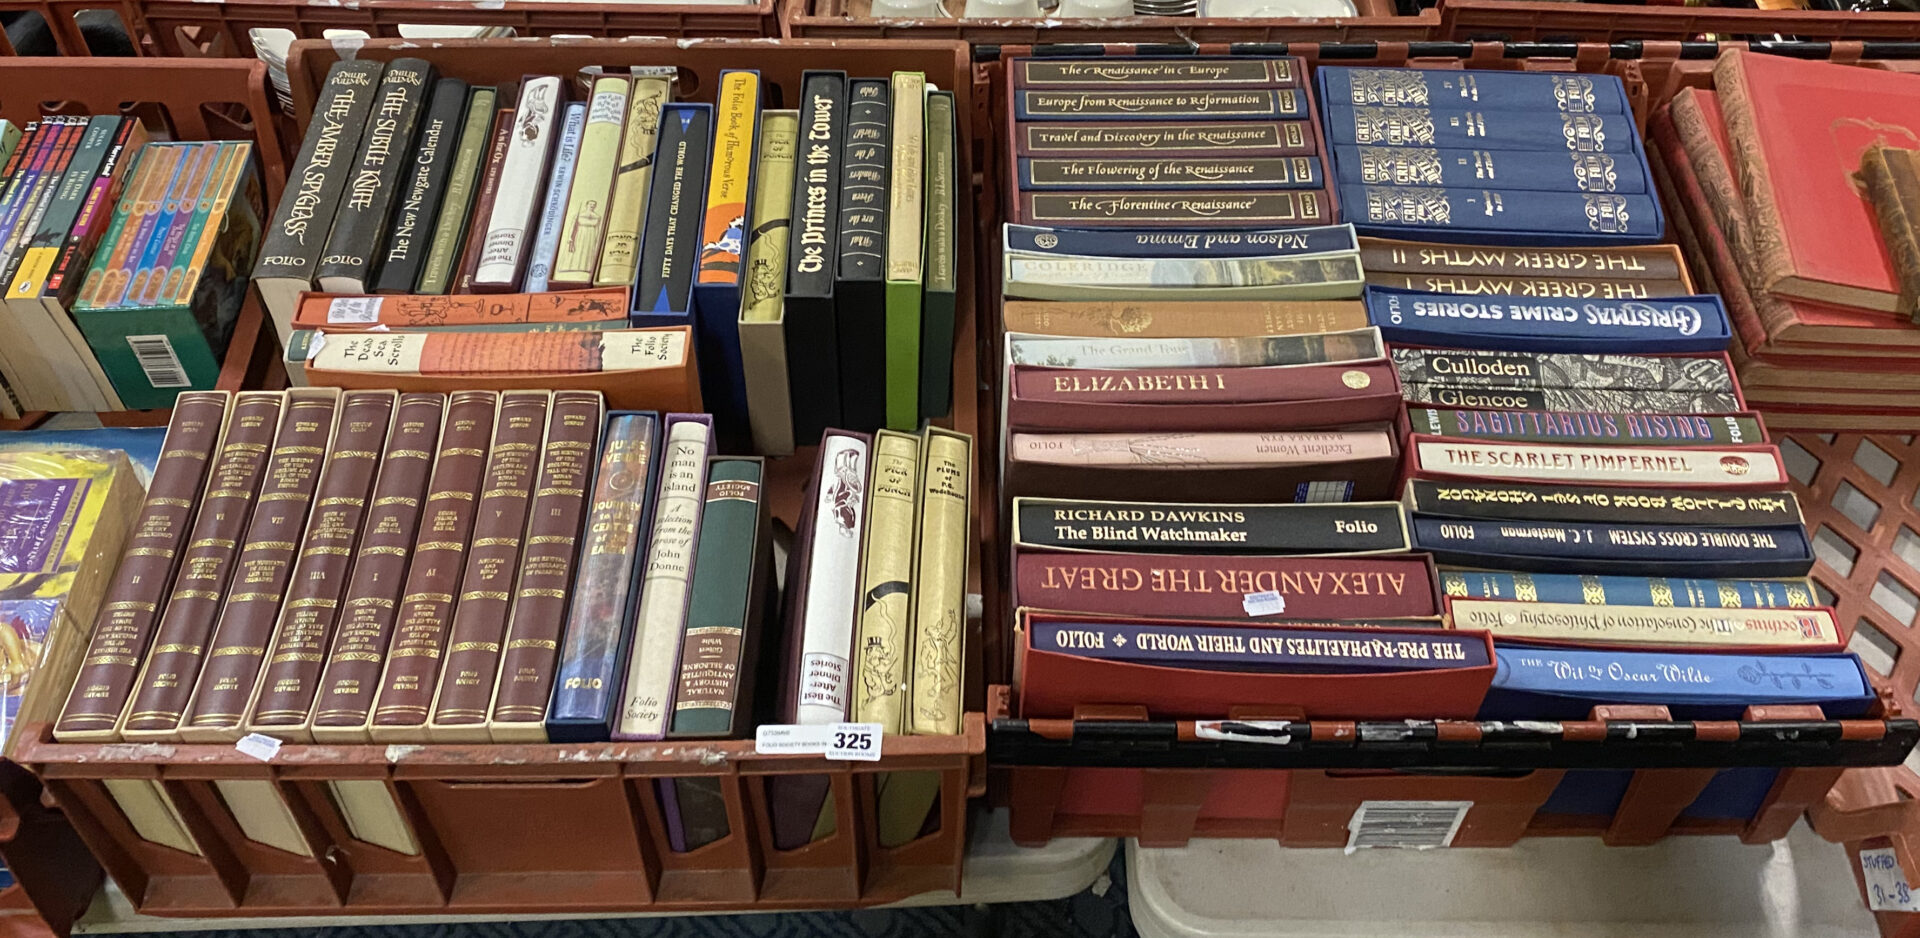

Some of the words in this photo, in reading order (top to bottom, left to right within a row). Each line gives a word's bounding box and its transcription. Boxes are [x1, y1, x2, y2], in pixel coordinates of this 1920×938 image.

[331, 76, 370, 86] PULLMAN
[337, 70, 367, 78] PHILIP
[1059, 66, 1081, 75] The
[1084, 65, 1163, 80] Renaissance
[1164, 66, 1174, 74] in
[1177, 65, 1229, 78] Europe
[734, 79, 746, 90] The
[331, 89, 355, 120] THE
[380, 87, 408, 118] THE
[732, 93, 744, 110] Folio
[1038, 97, 1077, 110] Europe
[1074, 95, 1106, 111] from
[1108, 95, 1173, 111] Renaissance
[1176, 96, 1186, 105] to
[1190, 93, 1259, 110] Reformation
[567, 113, 581, 132] What
[728, 113, 742, 130] Book
[809, 95, 834, 141] Tower
[303, 112, 344, 175] AMBER
[364, 118, 396, 166] SUBTLE
[418, 119, 443, 164] Calendar
[1039, 130, 1078, 143] Travel
[1080, 130, 1101, 143] and
[1104, 132, 1160, 146] Discovery
[1164, 130, 1175, 140] in
[1178, 130, 1195, 140] the
[1198, 129, 1266, 145] Renaissance
[561, 144, 574, 162] Life?
[677, 141, 686, 165] WORLD
[723, 140, 740, 180] Humorous
[806, 144, 831, 165] the
[675, 167, 683, 180] THE
[804, 168, 828, 183] in
[1061, 165, 1084, 175] The
[1088, 164, 1145, 179] Flowering
[1148, 162, 1163, 179] of
[1164, 164, 1182, 174] the
[1185, 164, 1255, 179] Renaissance
[349, 169, 382, 212] KNIFE
[404, 166, 431, 212] Newgate
[720, 179, 734, 198] Verse
[670, 182, 682, 215] CHANGED
[1069, 200, 1092, 210] The
[1095, 200, 1170, 216] Florentine
[1172, 198, 1256, 216] Renaissance
[284, 172, 325, 246] SPYGLASS
[396, 212, 417, 238] New
[667, 217, 677, 236] THAT
[665, 238, 674, 255] DAYS
[1136, 234, 1198, 248] Emma
[1202, 234, 1244, 248] and
[1247, 234, 1309, 249] Nelson
[388, 238, 410, 262] The
[1393, 249, 1406, 264] II
[1422, 249, 1506, 266] MYTHS
[263, 256, 305, 266] FOLIO
[322, 255, 363, 265] FOLIO
[662, 257, 672, 278] FIFTY
[798, 246, 825, 273] The
[1024, 261, 1149, 272] COLERIDGE
[1515, 251, 1588, 268] GREEK
[1595, 254, 1645, 271] THE
[1426, 278, 1513, 294] MYTHS
[1522, 281, 1596, 298] GREEK
[1603, 284, 1647, 299] THE
[1388, 295, 1402, 324] FOLIO
[1413, 302, 1502, 319] STORIES
[1509, 306, 1578, 322] CRIME
[1586, 303, 1702, 336] CHRISTMAS
[357, 338, 372, 362] Dead
[373, 338, 386, 357] Sea
[388, 335, 404, 365] Scrolls
[644, 336, 656, 356] Folio
[657, 332, 672, 361] Society
[1080, 345, 1104, 356] The
[1110, 345, 1153, 355] Grand
[1160, 344, 1187, 354] Tour
[1432, 357, 1532, 376] Culloden
[1054, 375, 1209, 393] ELIZABETH
[1216, 374, 1225, 390] I
[1438, 390, 1528, 408] Glencoe
[1456, 409, 1619, 439] SAGITTARIUS
[1629, 413, 1713, 441] RISING
[1731, 417, 1743, 444] FOLIO
[677, 446, 695, 456] No
[1030, 442, 1064, 450] FOLIO
[1256, 444, 1299, 456] Women
[1302, 444, 1352, 456] Excellent
[671, 459, 696, 467] man
[1445, 450, 1483, 465] THE
[1488, 452, 1577, 469] SCARLET
[1581, 454, 1693, 472] PIMPERNEL
[669, 470, 679, 479] is
[681, 471, 694, 479] an
[664, 482, 696, 493] island
[1437, 488, 1536, 502] SHONAGON
[1543, 493, 1580, 504] SEI
[1584, 494, 1609, 506] OF
[1614, 496, 1667, 508] BOOK
[1671, 498, 1745, 511] PILLOW
[1749, 499, 1786, 513] THE
[1054, 510, 1145, 522] RICHARD
[1151, 511, 1245, 524] DAWKINS
[1054, 526, 1087, 539] The
[1091, 526, 1137, 540] Blind
[1142, 528, 1248, 542] Watchmaker
[1335, 520, 1378, 533] Folio
[1440, 525, 1475, 538] FOLIO
[1501, 527, 1565, 542] Masterman
[1569, 529, 1581, 542] C.
[1584, 530, 1593, 544] J.
[1608, 529, 1656, 546] SYSTEM
[1659, 531, 1698, 546] CROSS
[1702, 533, 1749, 548] DOUBLE
[1754, 535, 1776, 549] THE
[657, 550, 680, 560] John
[649, 562, 684, 572] Donne
[1041, 567, 1143, 590] GREAT
[1152, 568, 1212, 593] THE
[1215, 570, 1406, 596] ALEXANDER
[1470, 612, 1503, 626] Folio
[1519, 612, 1599, 631] Philosophy
[1602, 615, 1615, 630] of
[1617, 615, 1697, 633] Consolation
[1056, 630, 1105, 648] FOLIO
[1137, 634, 1195, 650] WORLD
[1198, 635, 1245, 653] THEIR
[1249, 637, 1283, 654] AND
[1286, 638, 1429, 660] PRE-RAPHAELITES
[1433, 643, 1465, 660] THE
[810, 659, 841, 671] Stories
[1520, 658, 1544, 667] THE
[1546, 660, 1585, 679] Wit
[1607, 662, 1658, 683] Oscar
[1655, 663, 1712, 684] Wilde
[565, 677, 602, 690] FOLIO
[809, 670, 841, 683] Dinner
[631, 696, 658, 707] Folio
[804, 692, 824, 701] Best
[826, 694, 841, 705] The
[625, 709, 658, 721] Society
[834, 732, 872, 750] 325
